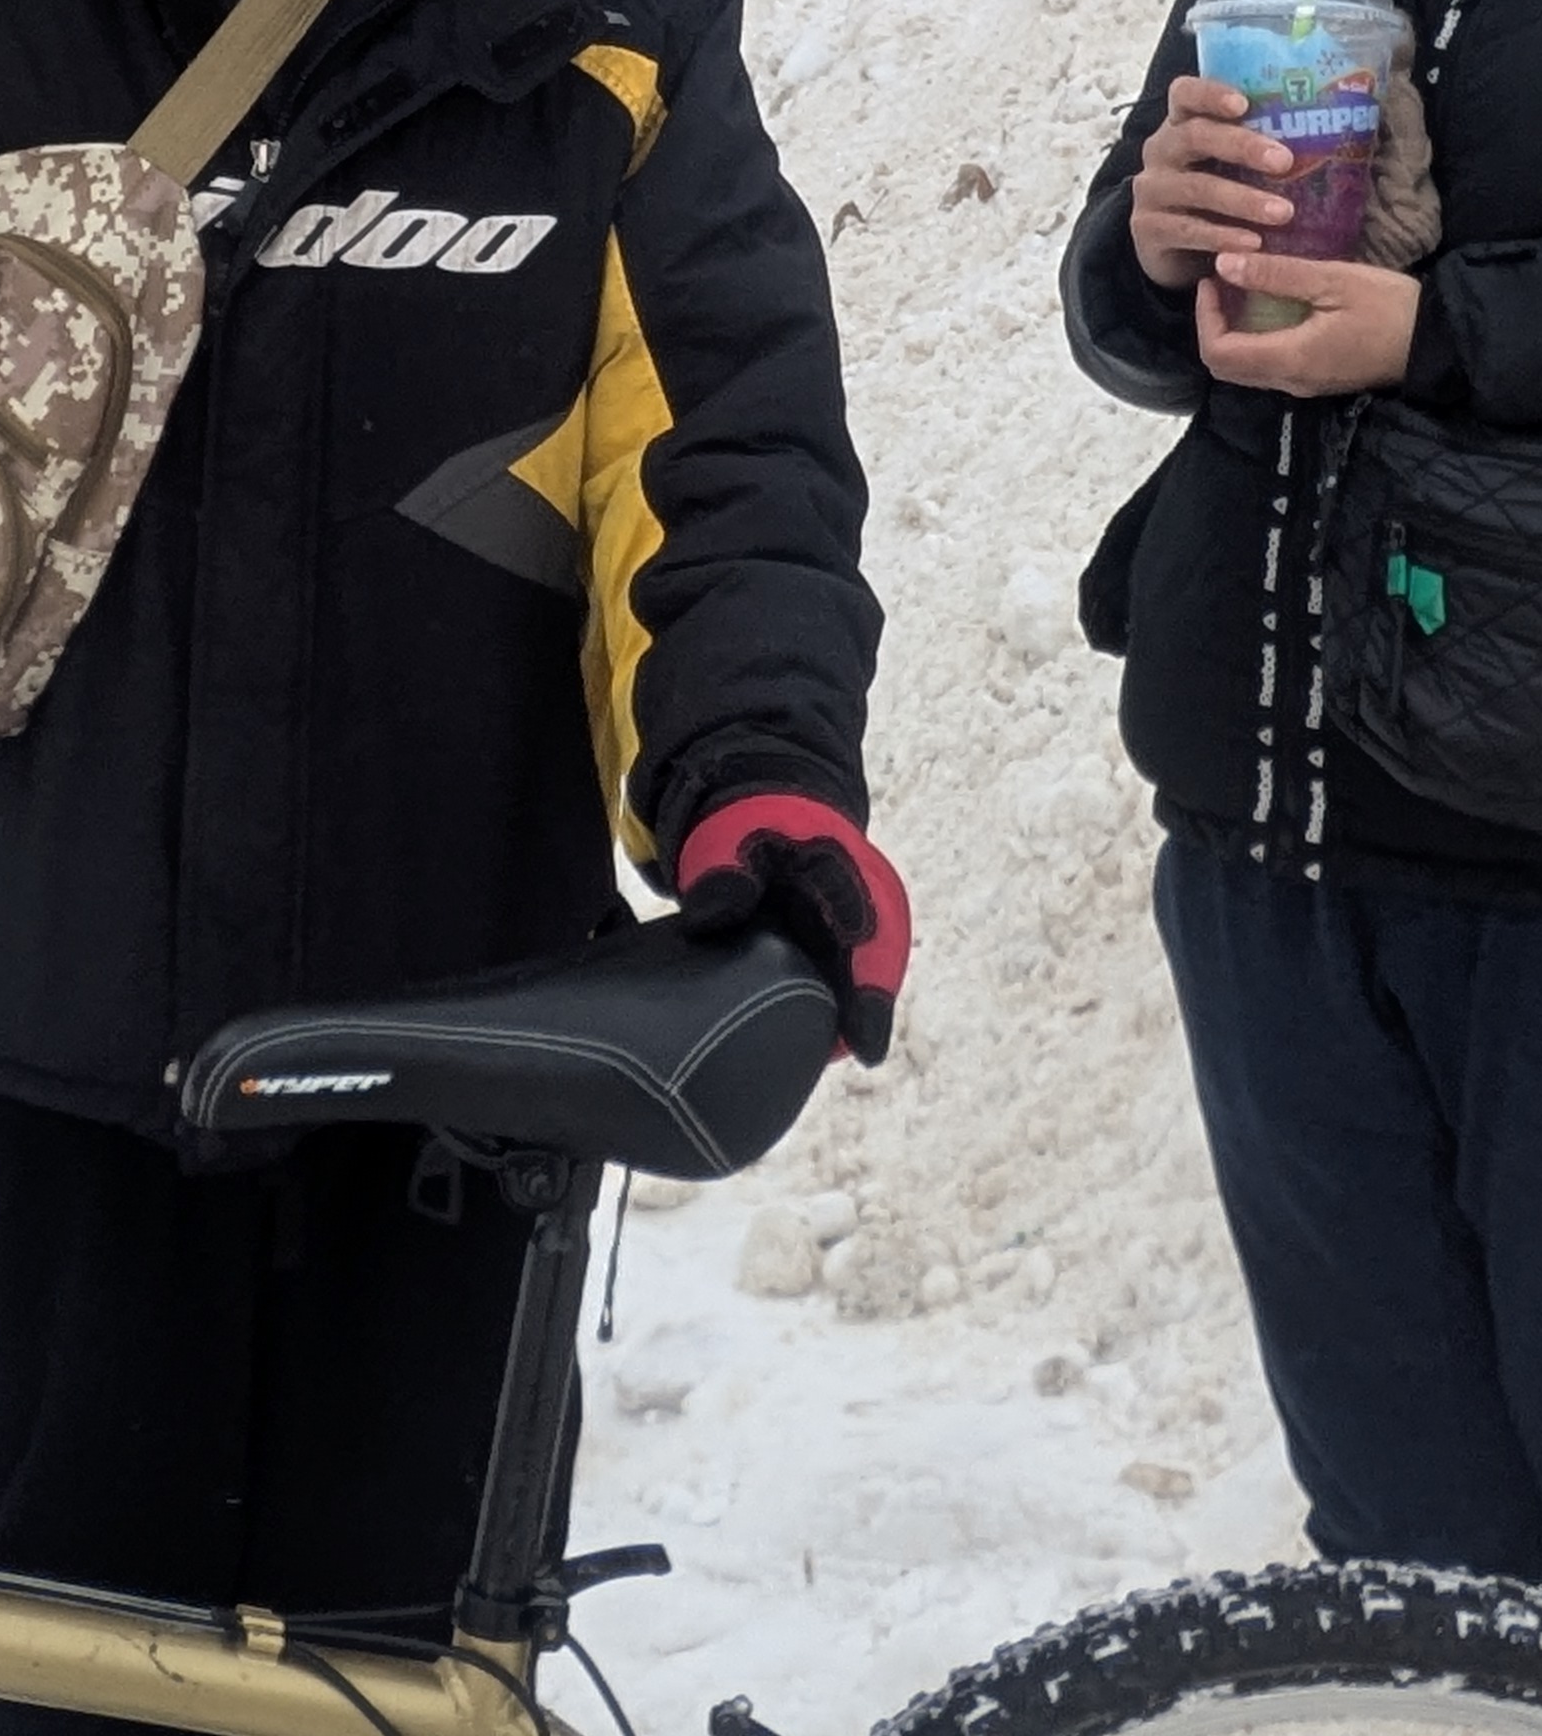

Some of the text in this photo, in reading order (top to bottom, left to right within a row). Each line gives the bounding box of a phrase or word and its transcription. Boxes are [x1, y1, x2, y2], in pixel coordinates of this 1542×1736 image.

[1263, 528, 1282, 592] Reebok
[1259, 643, 1276, 707] Reebok
[1253, 759, 1273, 823] Reebok
[1304, 780, 1326, 844] Reebok
